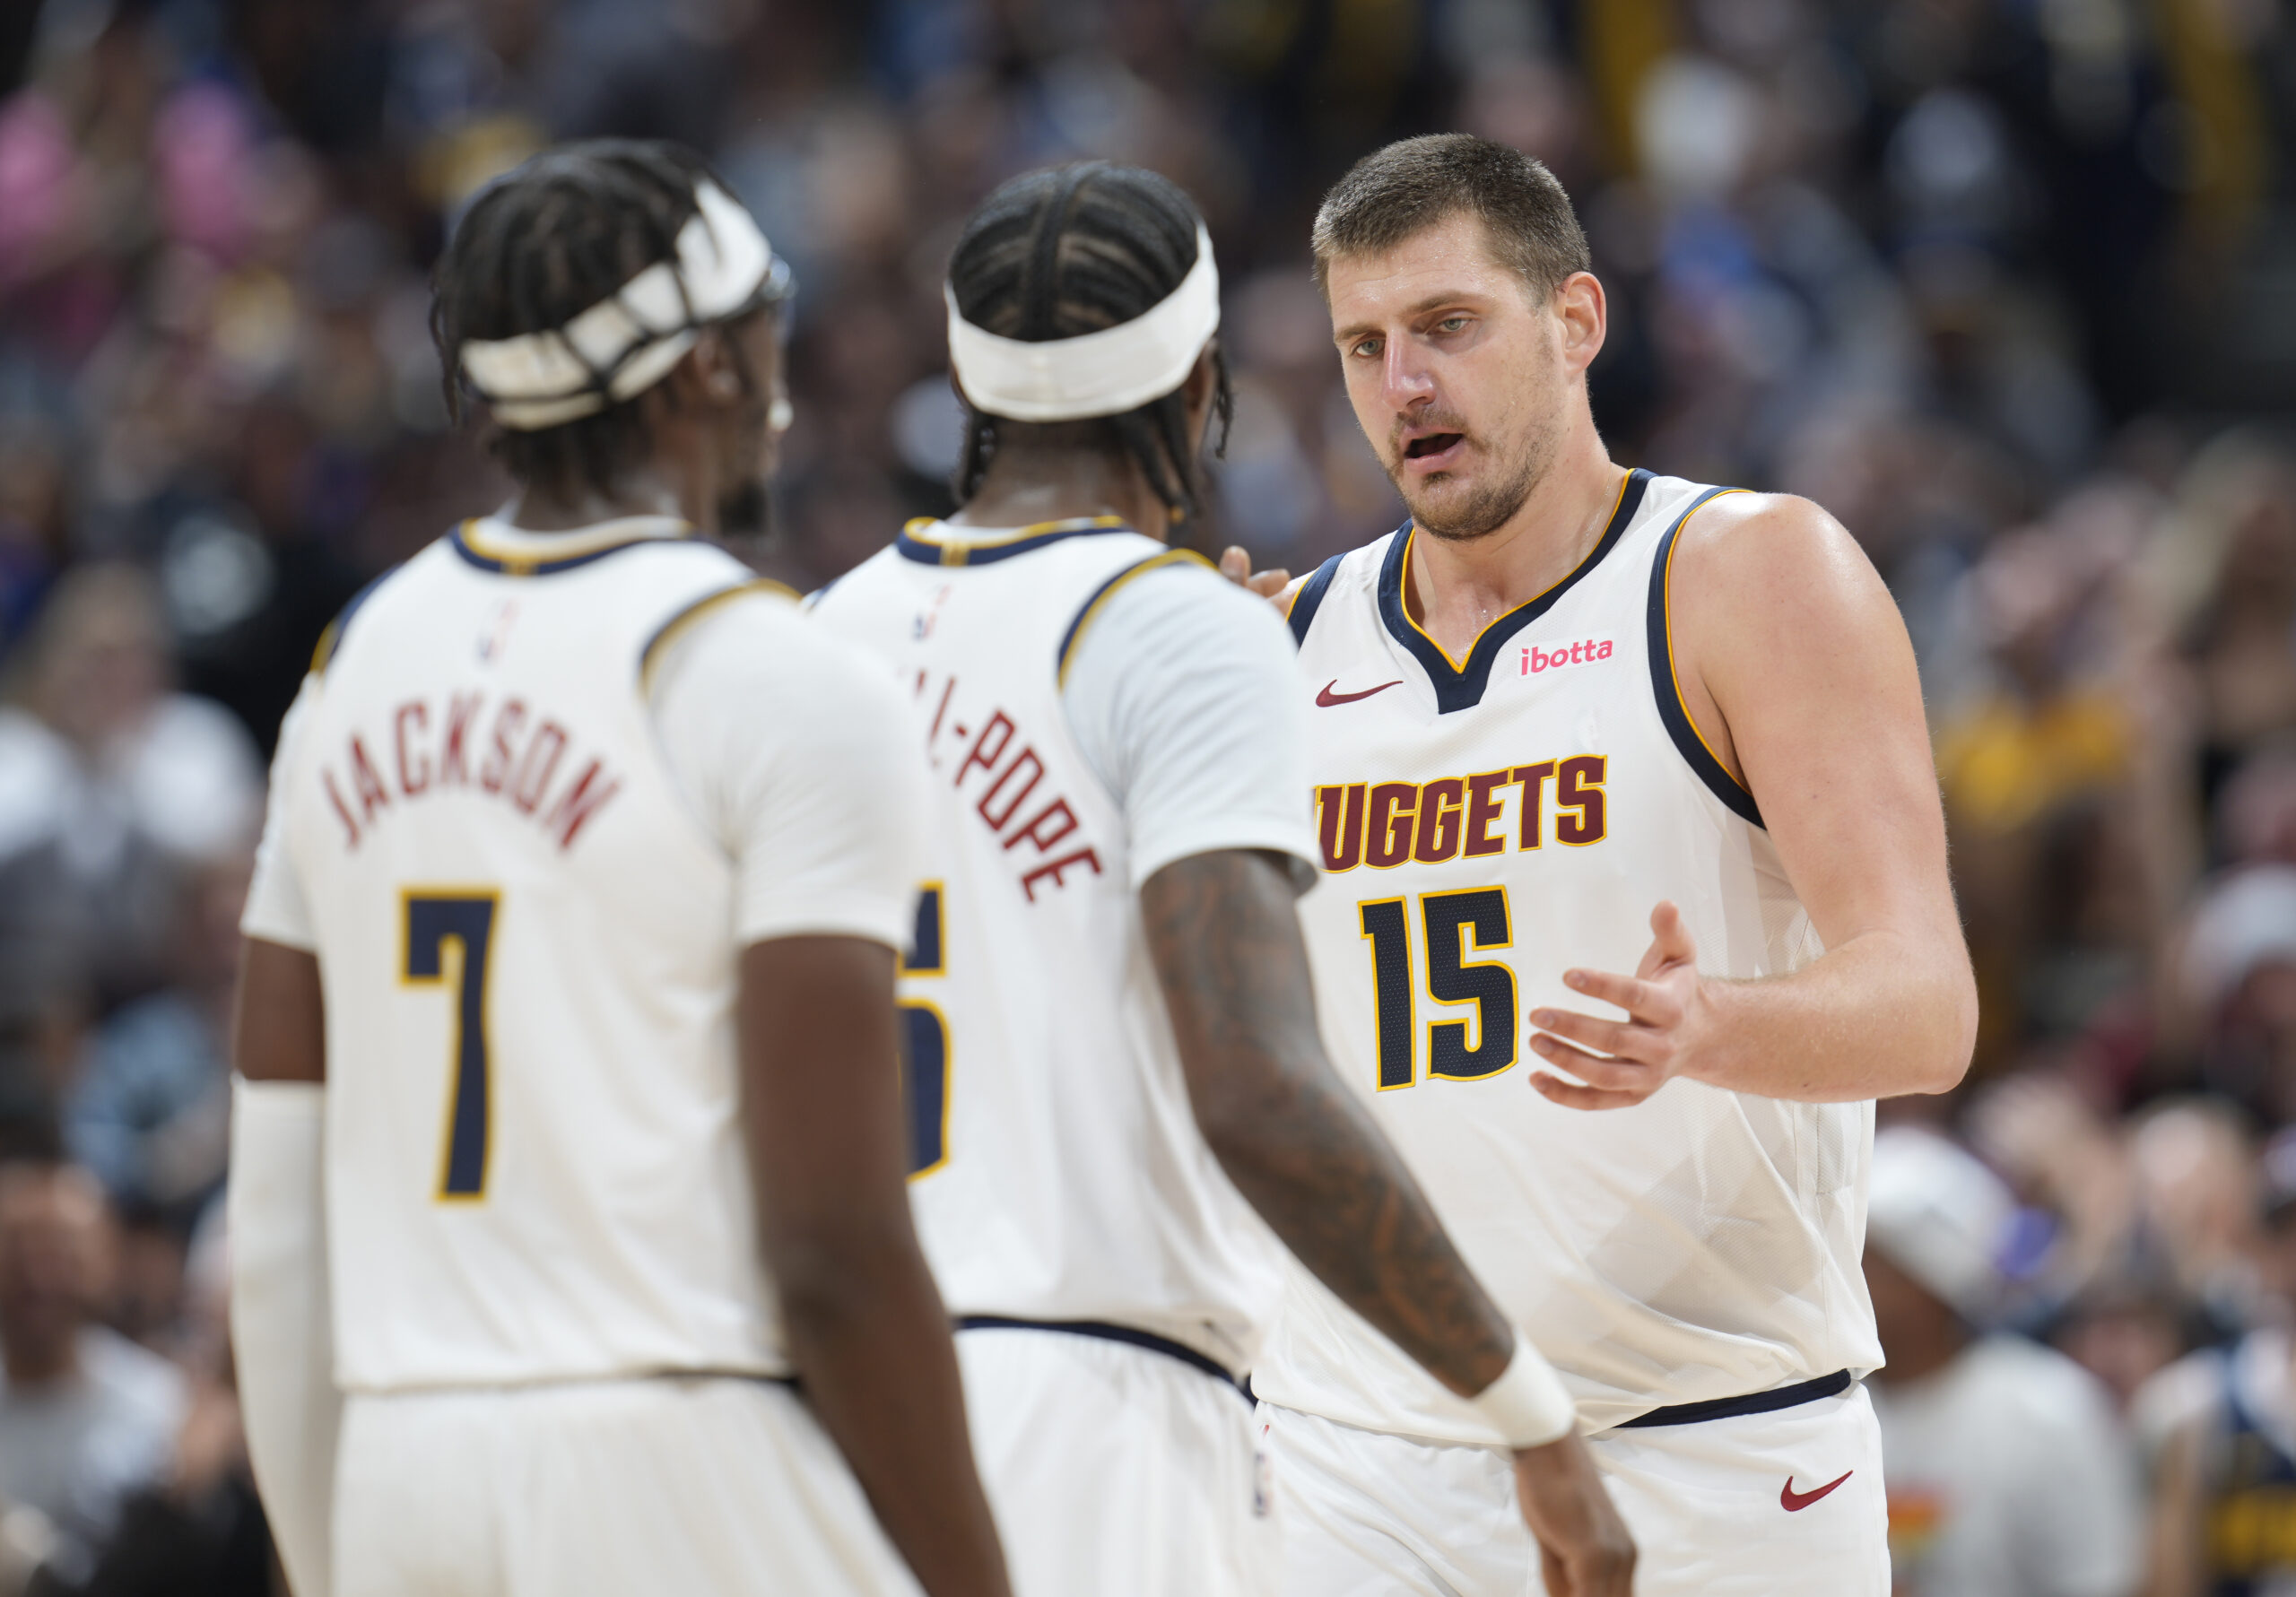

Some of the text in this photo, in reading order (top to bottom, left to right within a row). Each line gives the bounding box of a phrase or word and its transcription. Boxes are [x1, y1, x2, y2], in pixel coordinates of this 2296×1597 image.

[1521, 639, 1613, 675] ibotta
[321, 690, 624, 854] JACKSON
[1312, 753, 1607, 873] UGGETS
[397, 883, 503, 1202] 7
[1357, 885, 1519, 1092] 15
